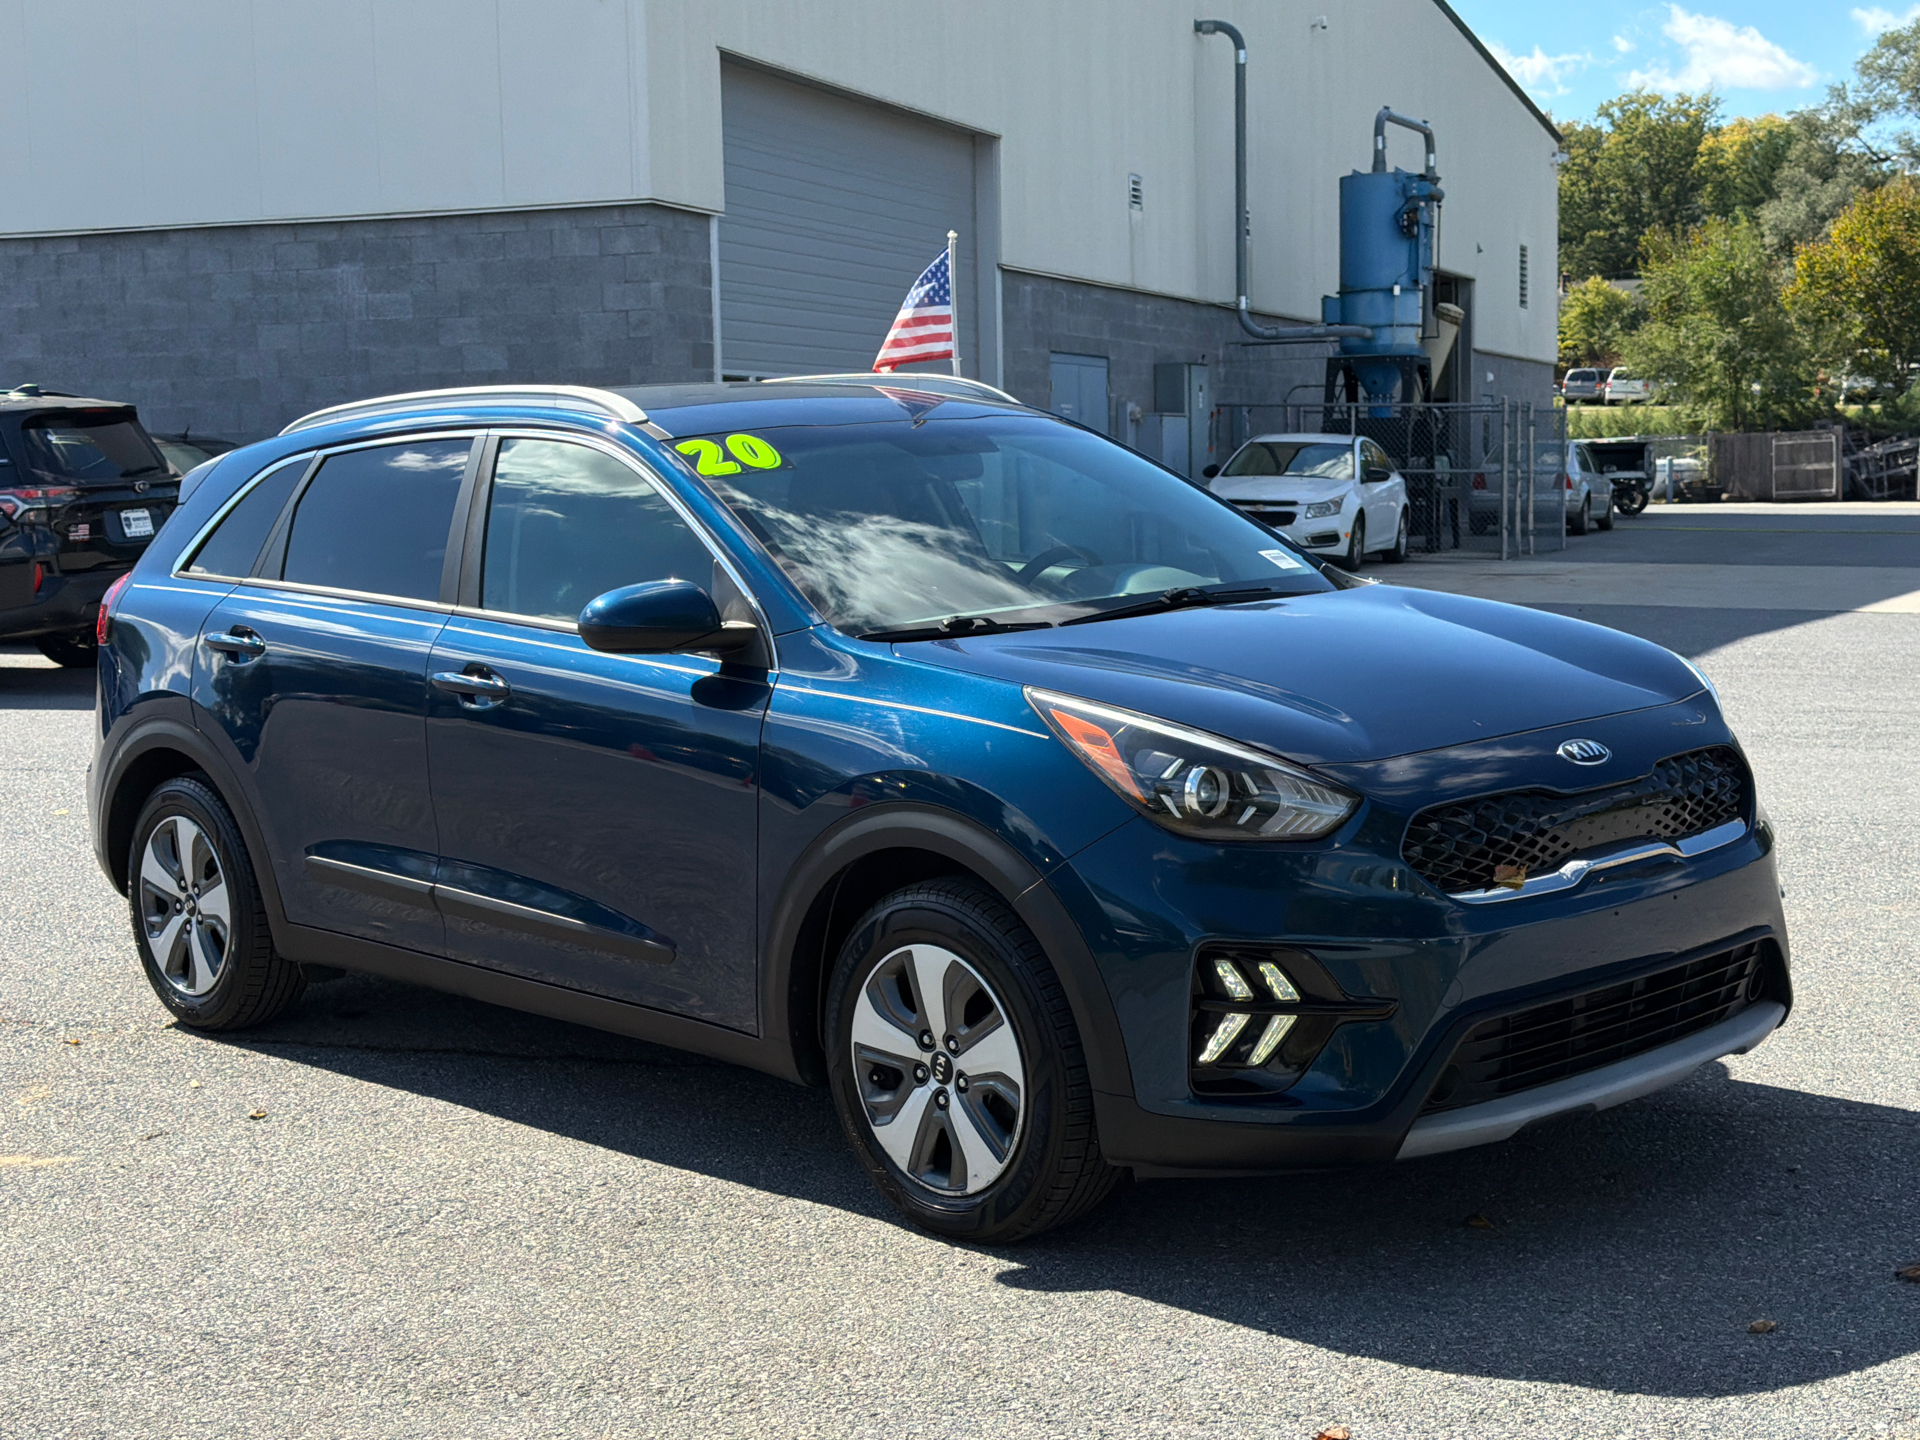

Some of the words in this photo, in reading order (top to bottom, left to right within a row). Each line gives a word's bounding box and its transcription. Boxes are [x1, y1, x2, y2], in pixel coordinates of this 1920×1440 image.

[675, 434, 782, 476] 20
[1564, 740, 1606, 760] KIA
[935, 1055, 946, 1080] KIA
